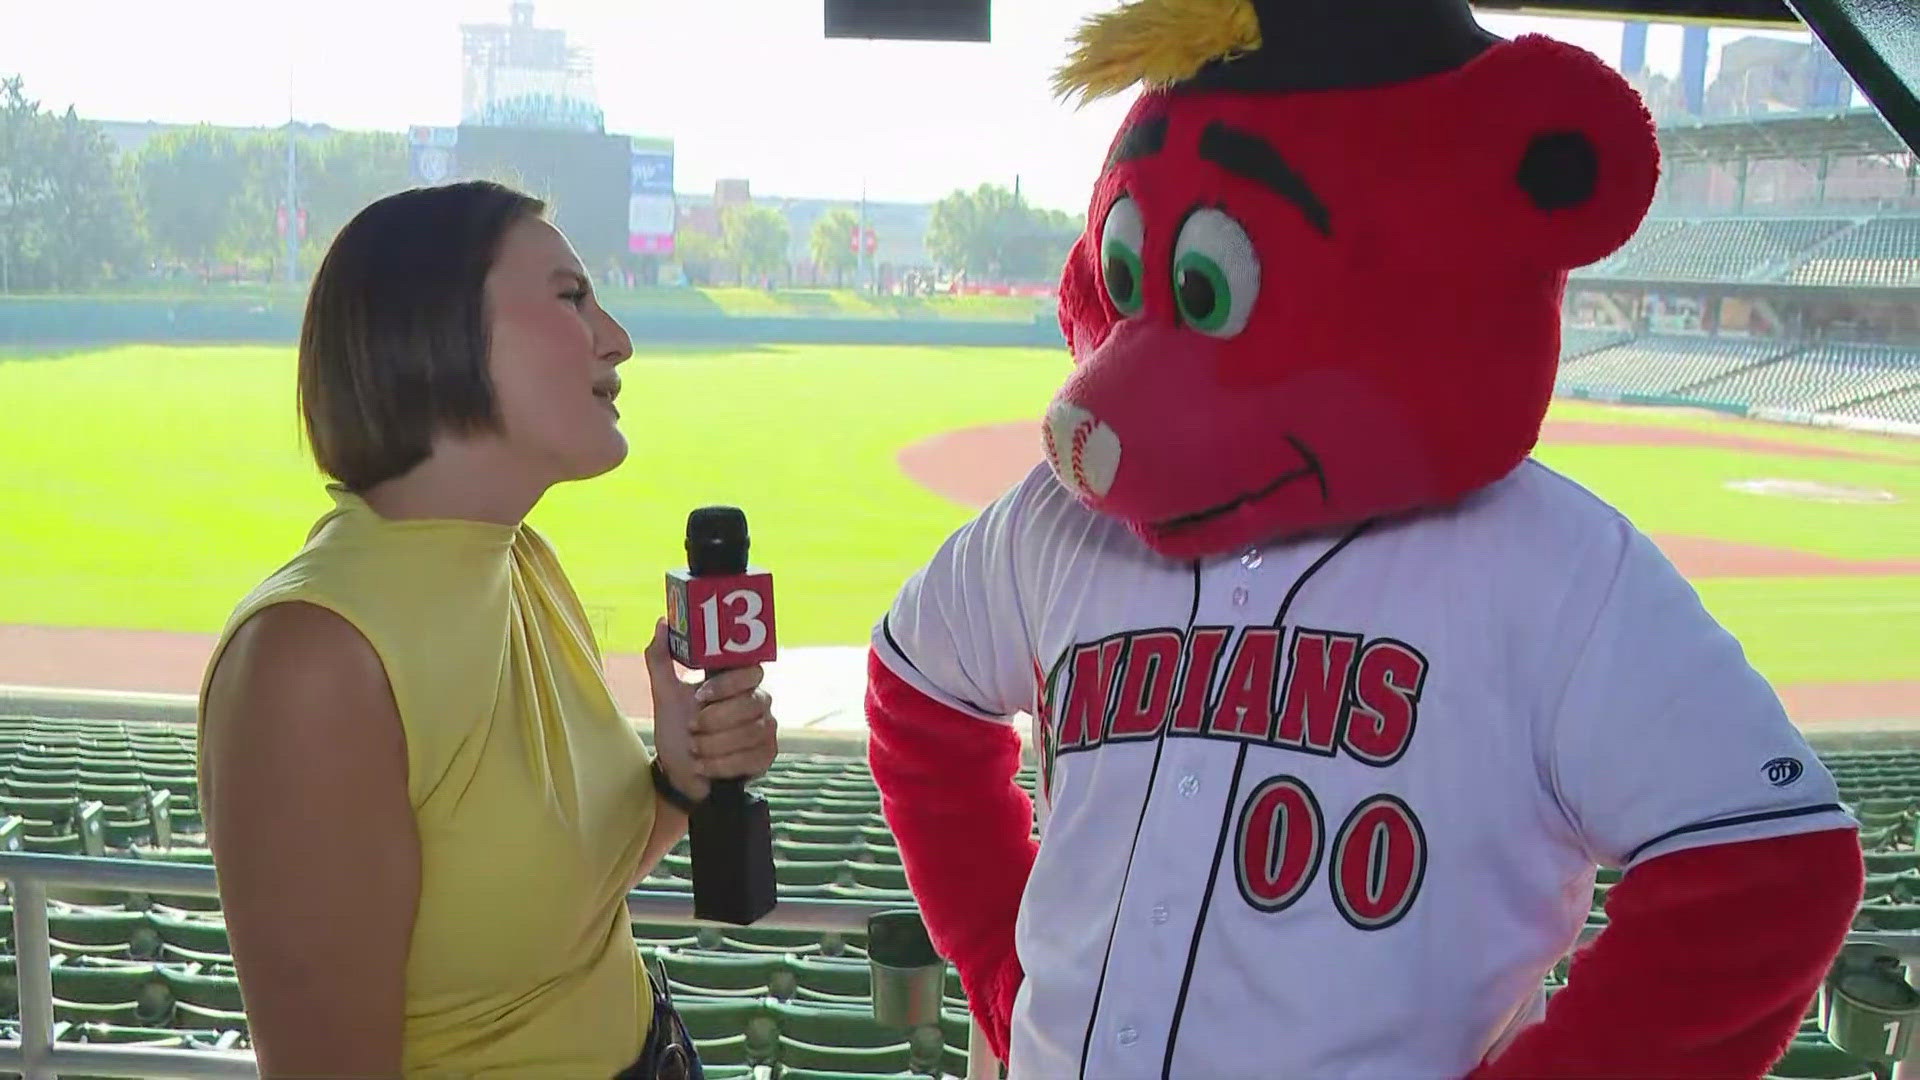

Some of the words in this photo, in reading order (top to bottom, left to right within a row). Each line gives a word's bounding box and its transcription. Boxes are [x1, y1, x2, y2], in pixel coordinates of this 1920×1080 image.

[700, 589, 767, 656] 13
[1234, 774, 1427, 931] 00
[1883, 1021, 1900, 1056] 1
